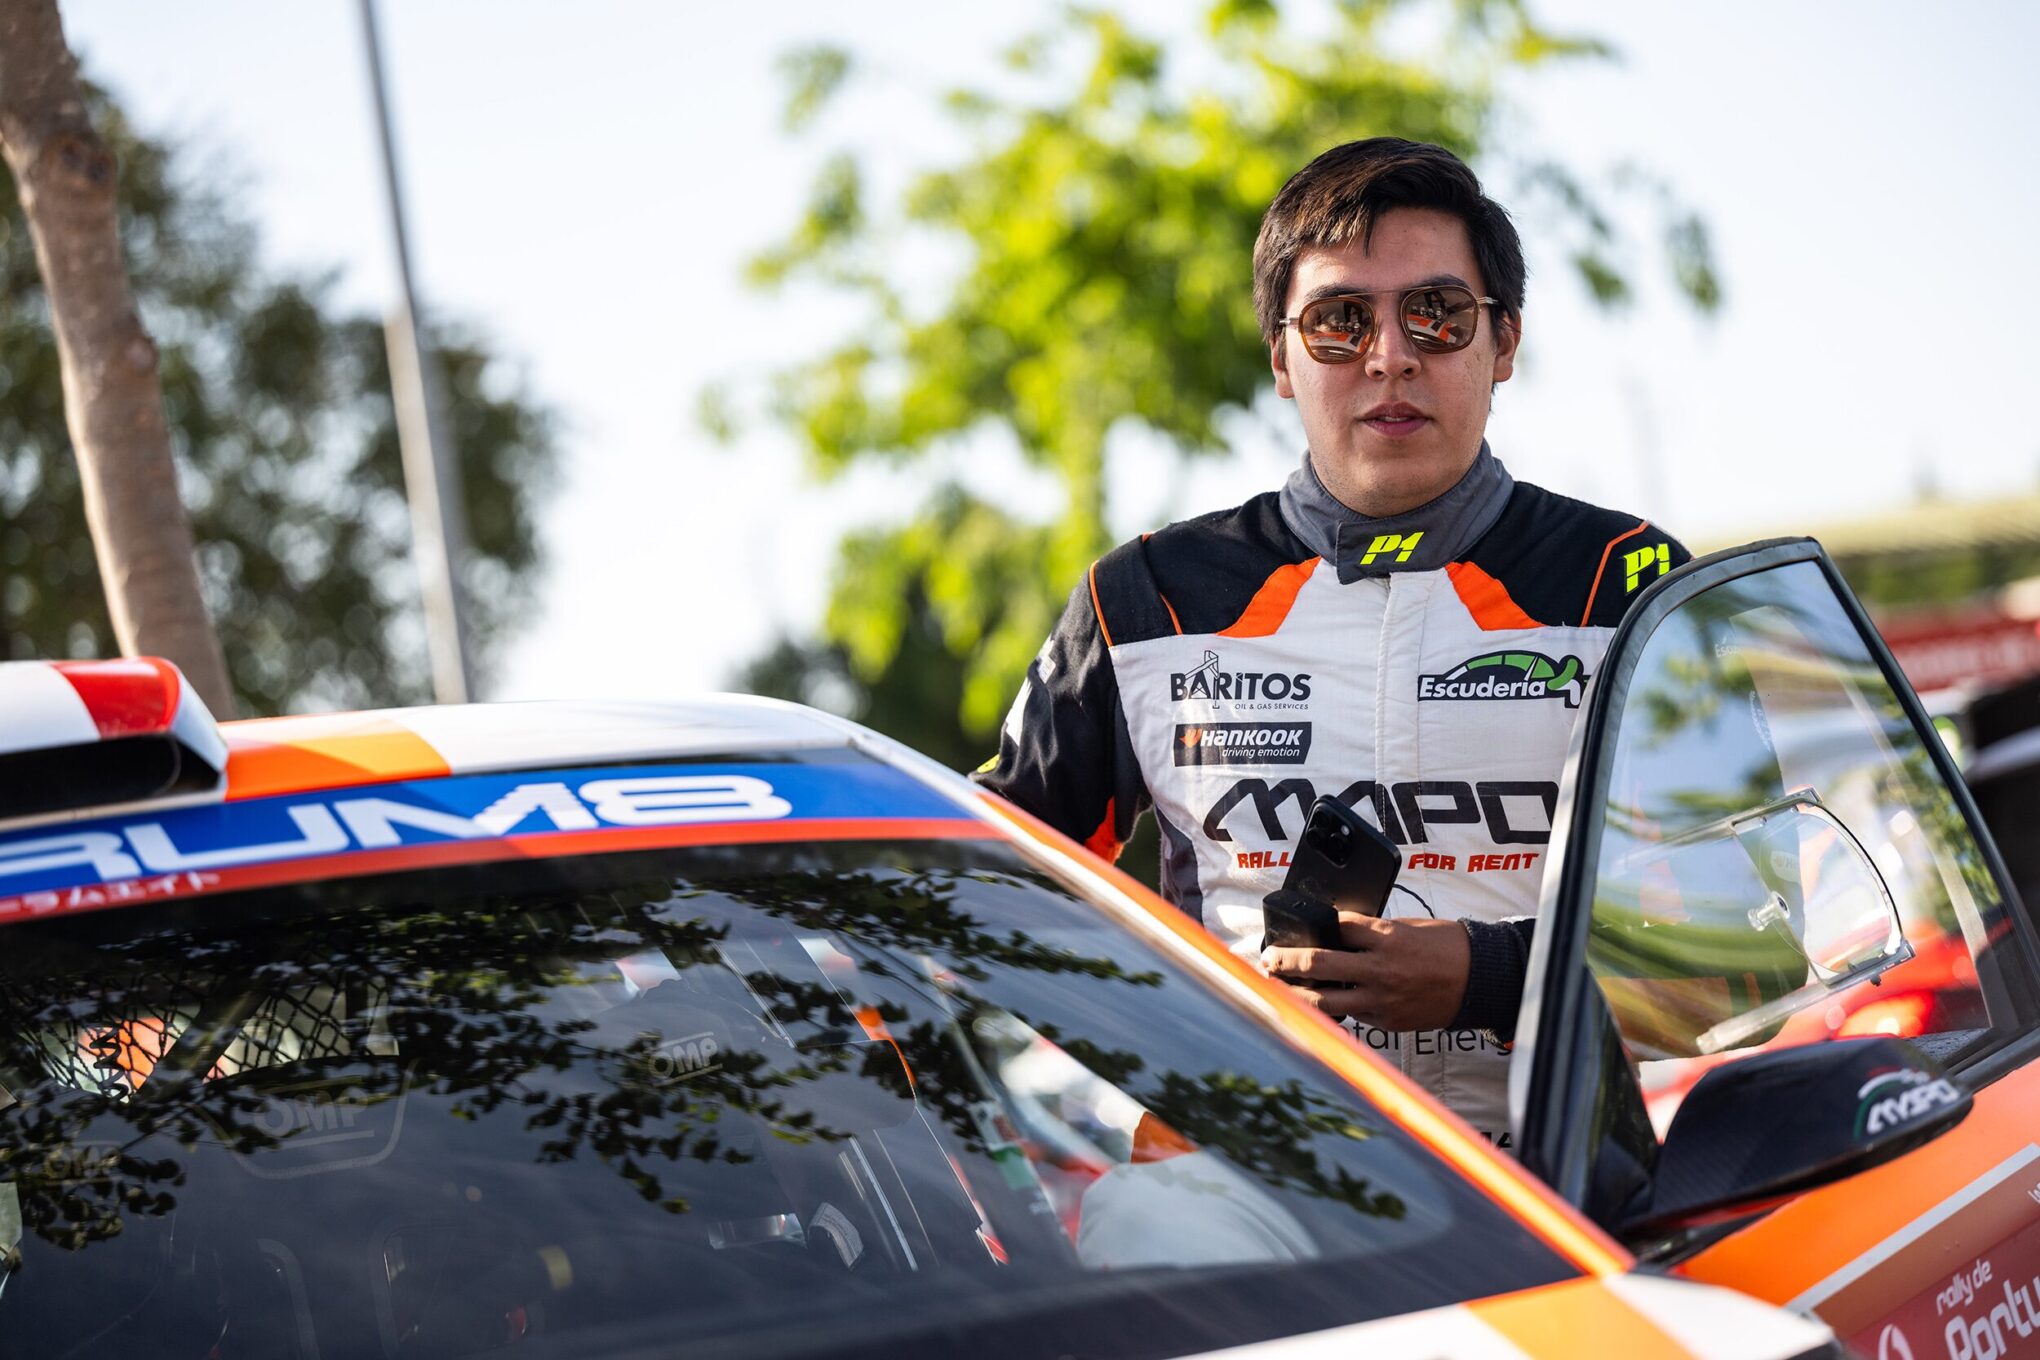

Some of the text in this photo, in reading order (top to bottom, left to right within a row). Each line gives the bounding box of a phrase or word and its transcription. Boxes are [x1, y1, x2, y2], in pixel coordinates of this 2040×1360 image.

[1359, 531, 1425, 566] P1
[1622, 543, 1671, 594] P1
[1419, 675, 1546, 698] Escuderia
[1274, 702, 1309, 710] SERVICES
[1222, 747, 1300, 758] driving emotion
[1237, 851, 1540, 873] RALL FOR RENT
[648, 1038, 718, 1079] OMP
[254, 1087, 369, 1138] OMP
[1936, 1258, 1993, 1317] rally de
